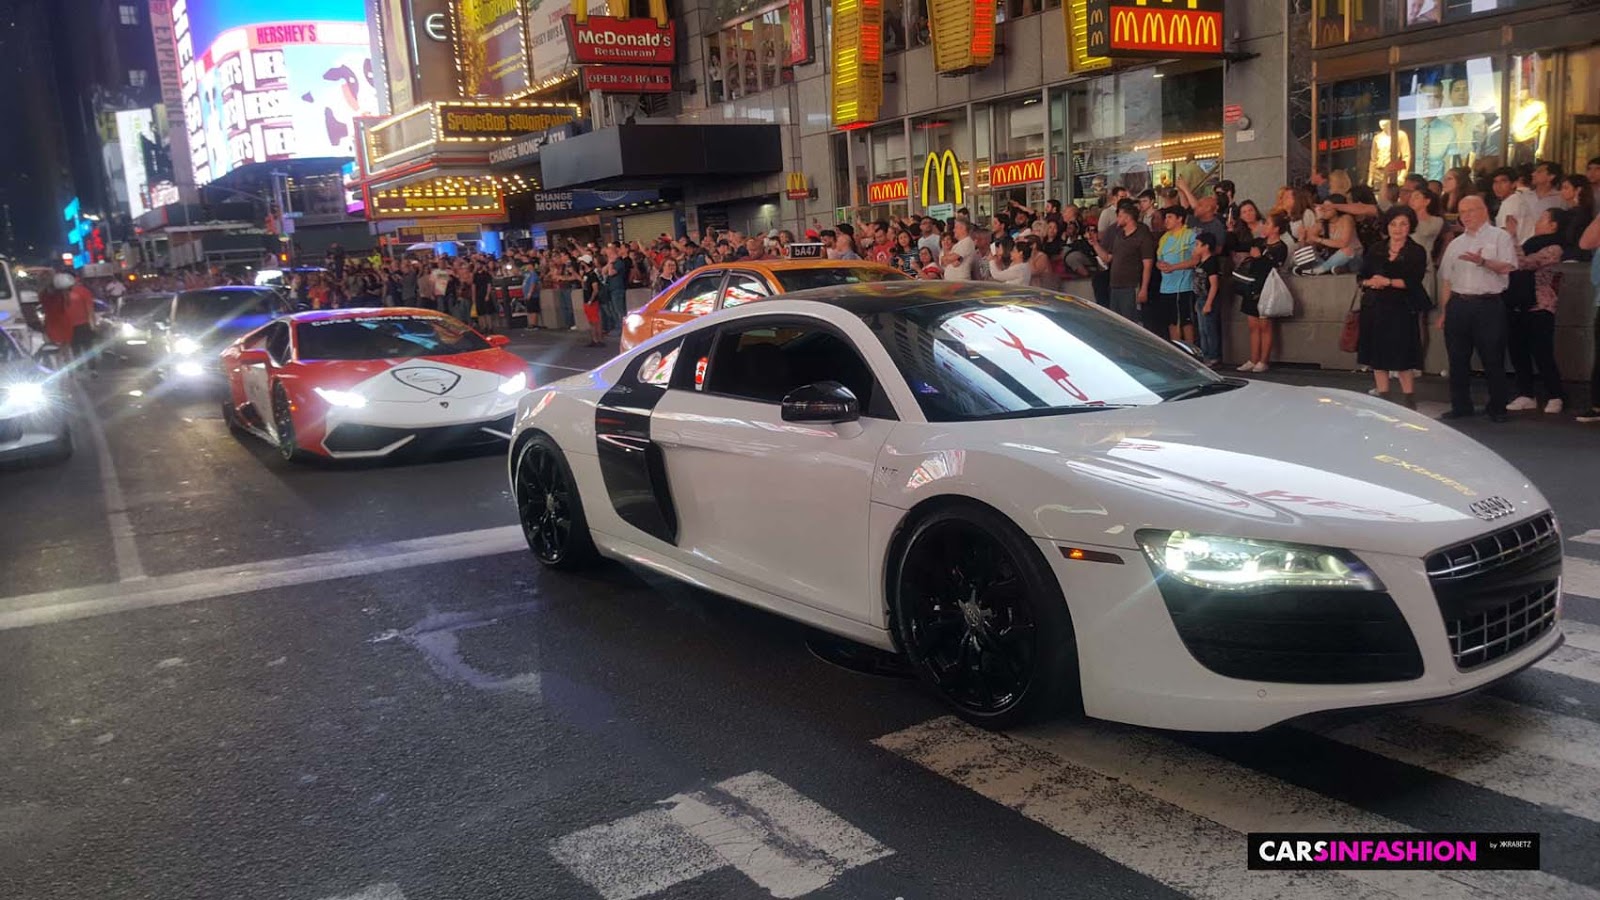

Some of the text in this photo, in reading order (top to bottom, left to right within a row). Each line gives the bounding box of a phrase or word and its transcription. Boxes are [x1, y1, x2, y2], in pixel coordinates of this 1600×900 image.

[256, 24, 316, 45] HERSHEY'S
[578, 30, 671, 47] McDonald's
[594, 47, 656, 57] Restaurant
[155, 25, 184, 128] EXPERIENCE
[588, 74, 618, 84] OPEN
[620, 74, 633, 84] 24
[489, 144, 518, 164] CHANGE
[548, 130, 566, 144] ATM
[535, 193, 573, 202] CHANGE
[536, 201, 573, 211] MONEY
